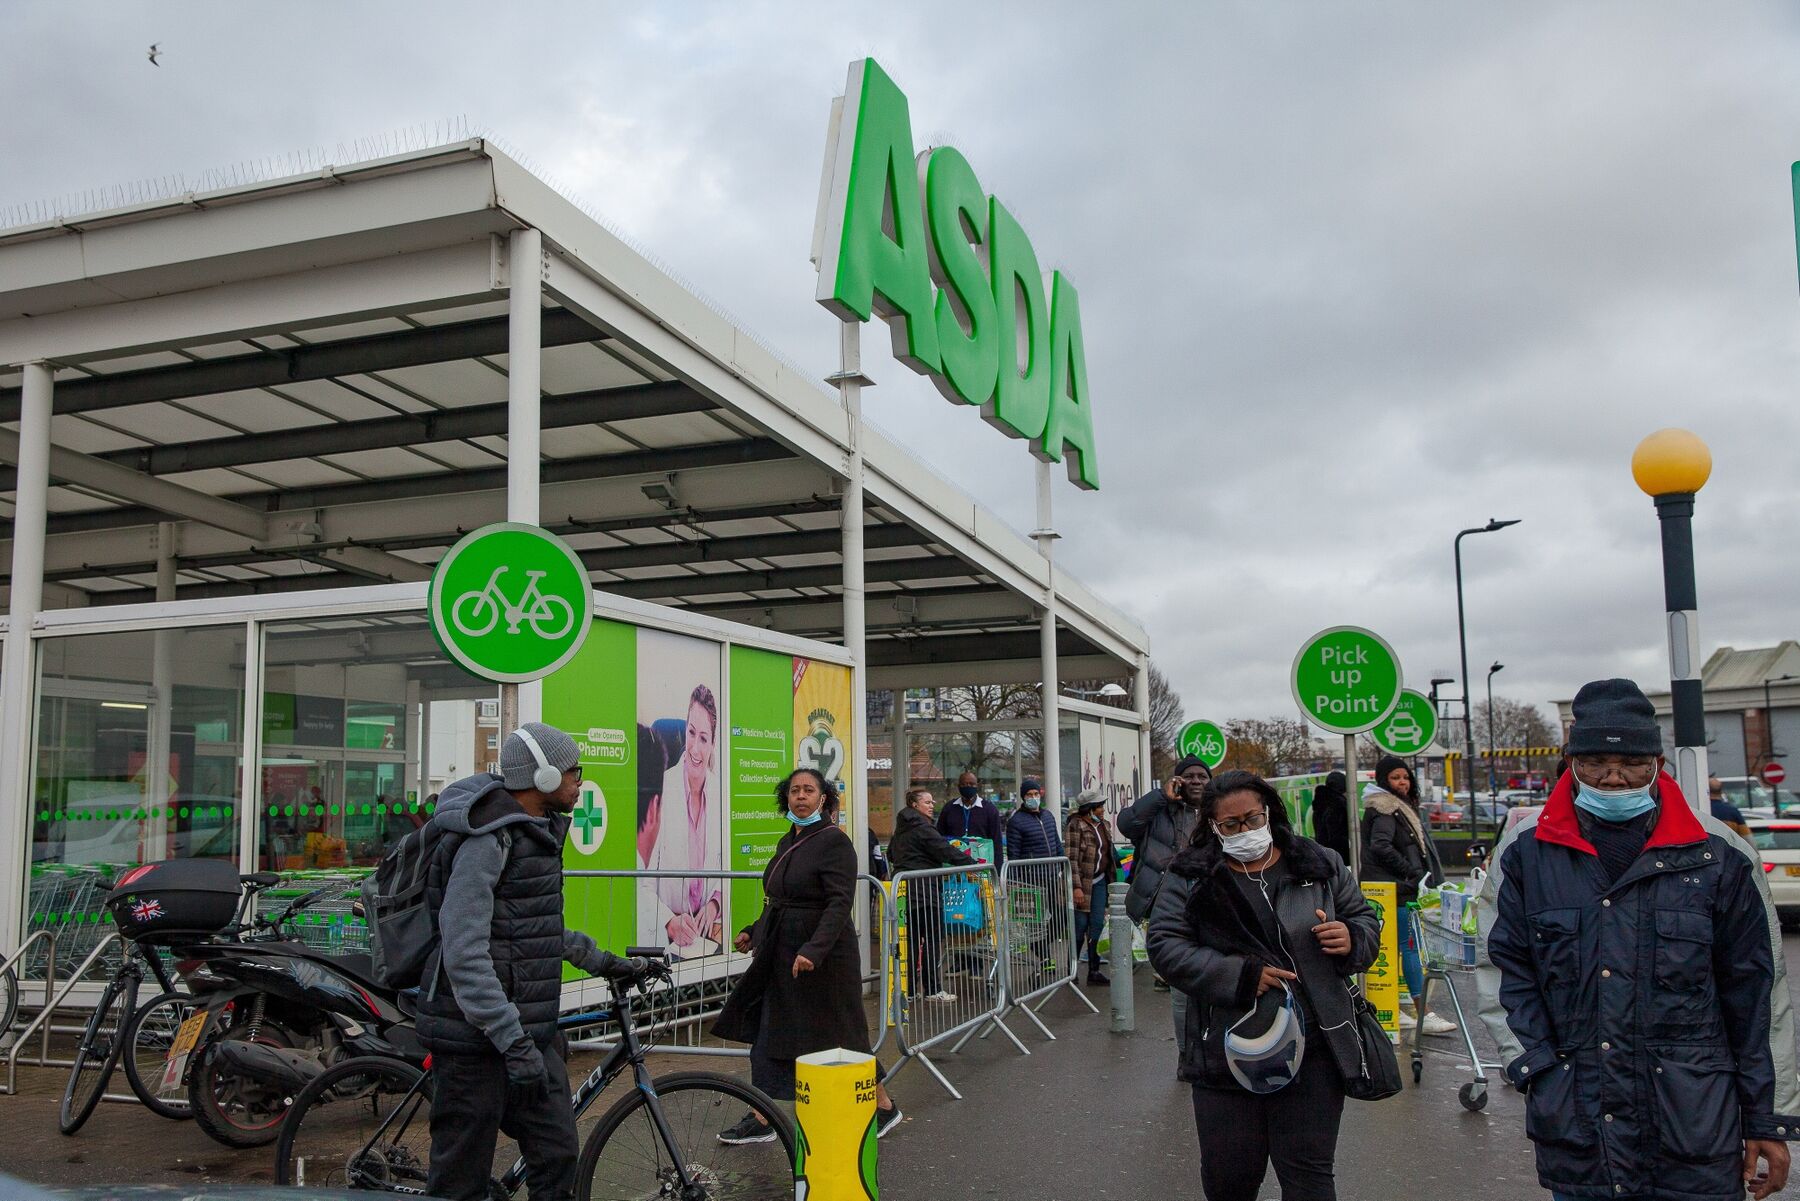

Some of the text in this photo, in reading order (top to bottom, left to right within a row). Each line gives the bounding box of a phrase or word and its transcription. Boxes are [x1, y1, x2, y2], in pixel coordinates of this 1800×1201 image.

[819, 57, 1100, 490] ASDA
[1321, 644, 1369, 665] Pick
[1331, 669, 1361, 688] up
[1316, 694, 1379, 713] Point
[1396, 700, 1413, 709] axi
[743, 728, 763, 737] Medicine
[578, 742, 625, 760] Pharmacy
[740, 759, 778, 769] Free Prescription
[740, 774, 762, 783] Collection
[732, 811, 754, 819] Extended
[755, 811, 774, 820] Opening
[165, 1060, 177, 1083] L
[804, 1081, 811, 1092] A
[855, 1090, 876, 1104] FACE
